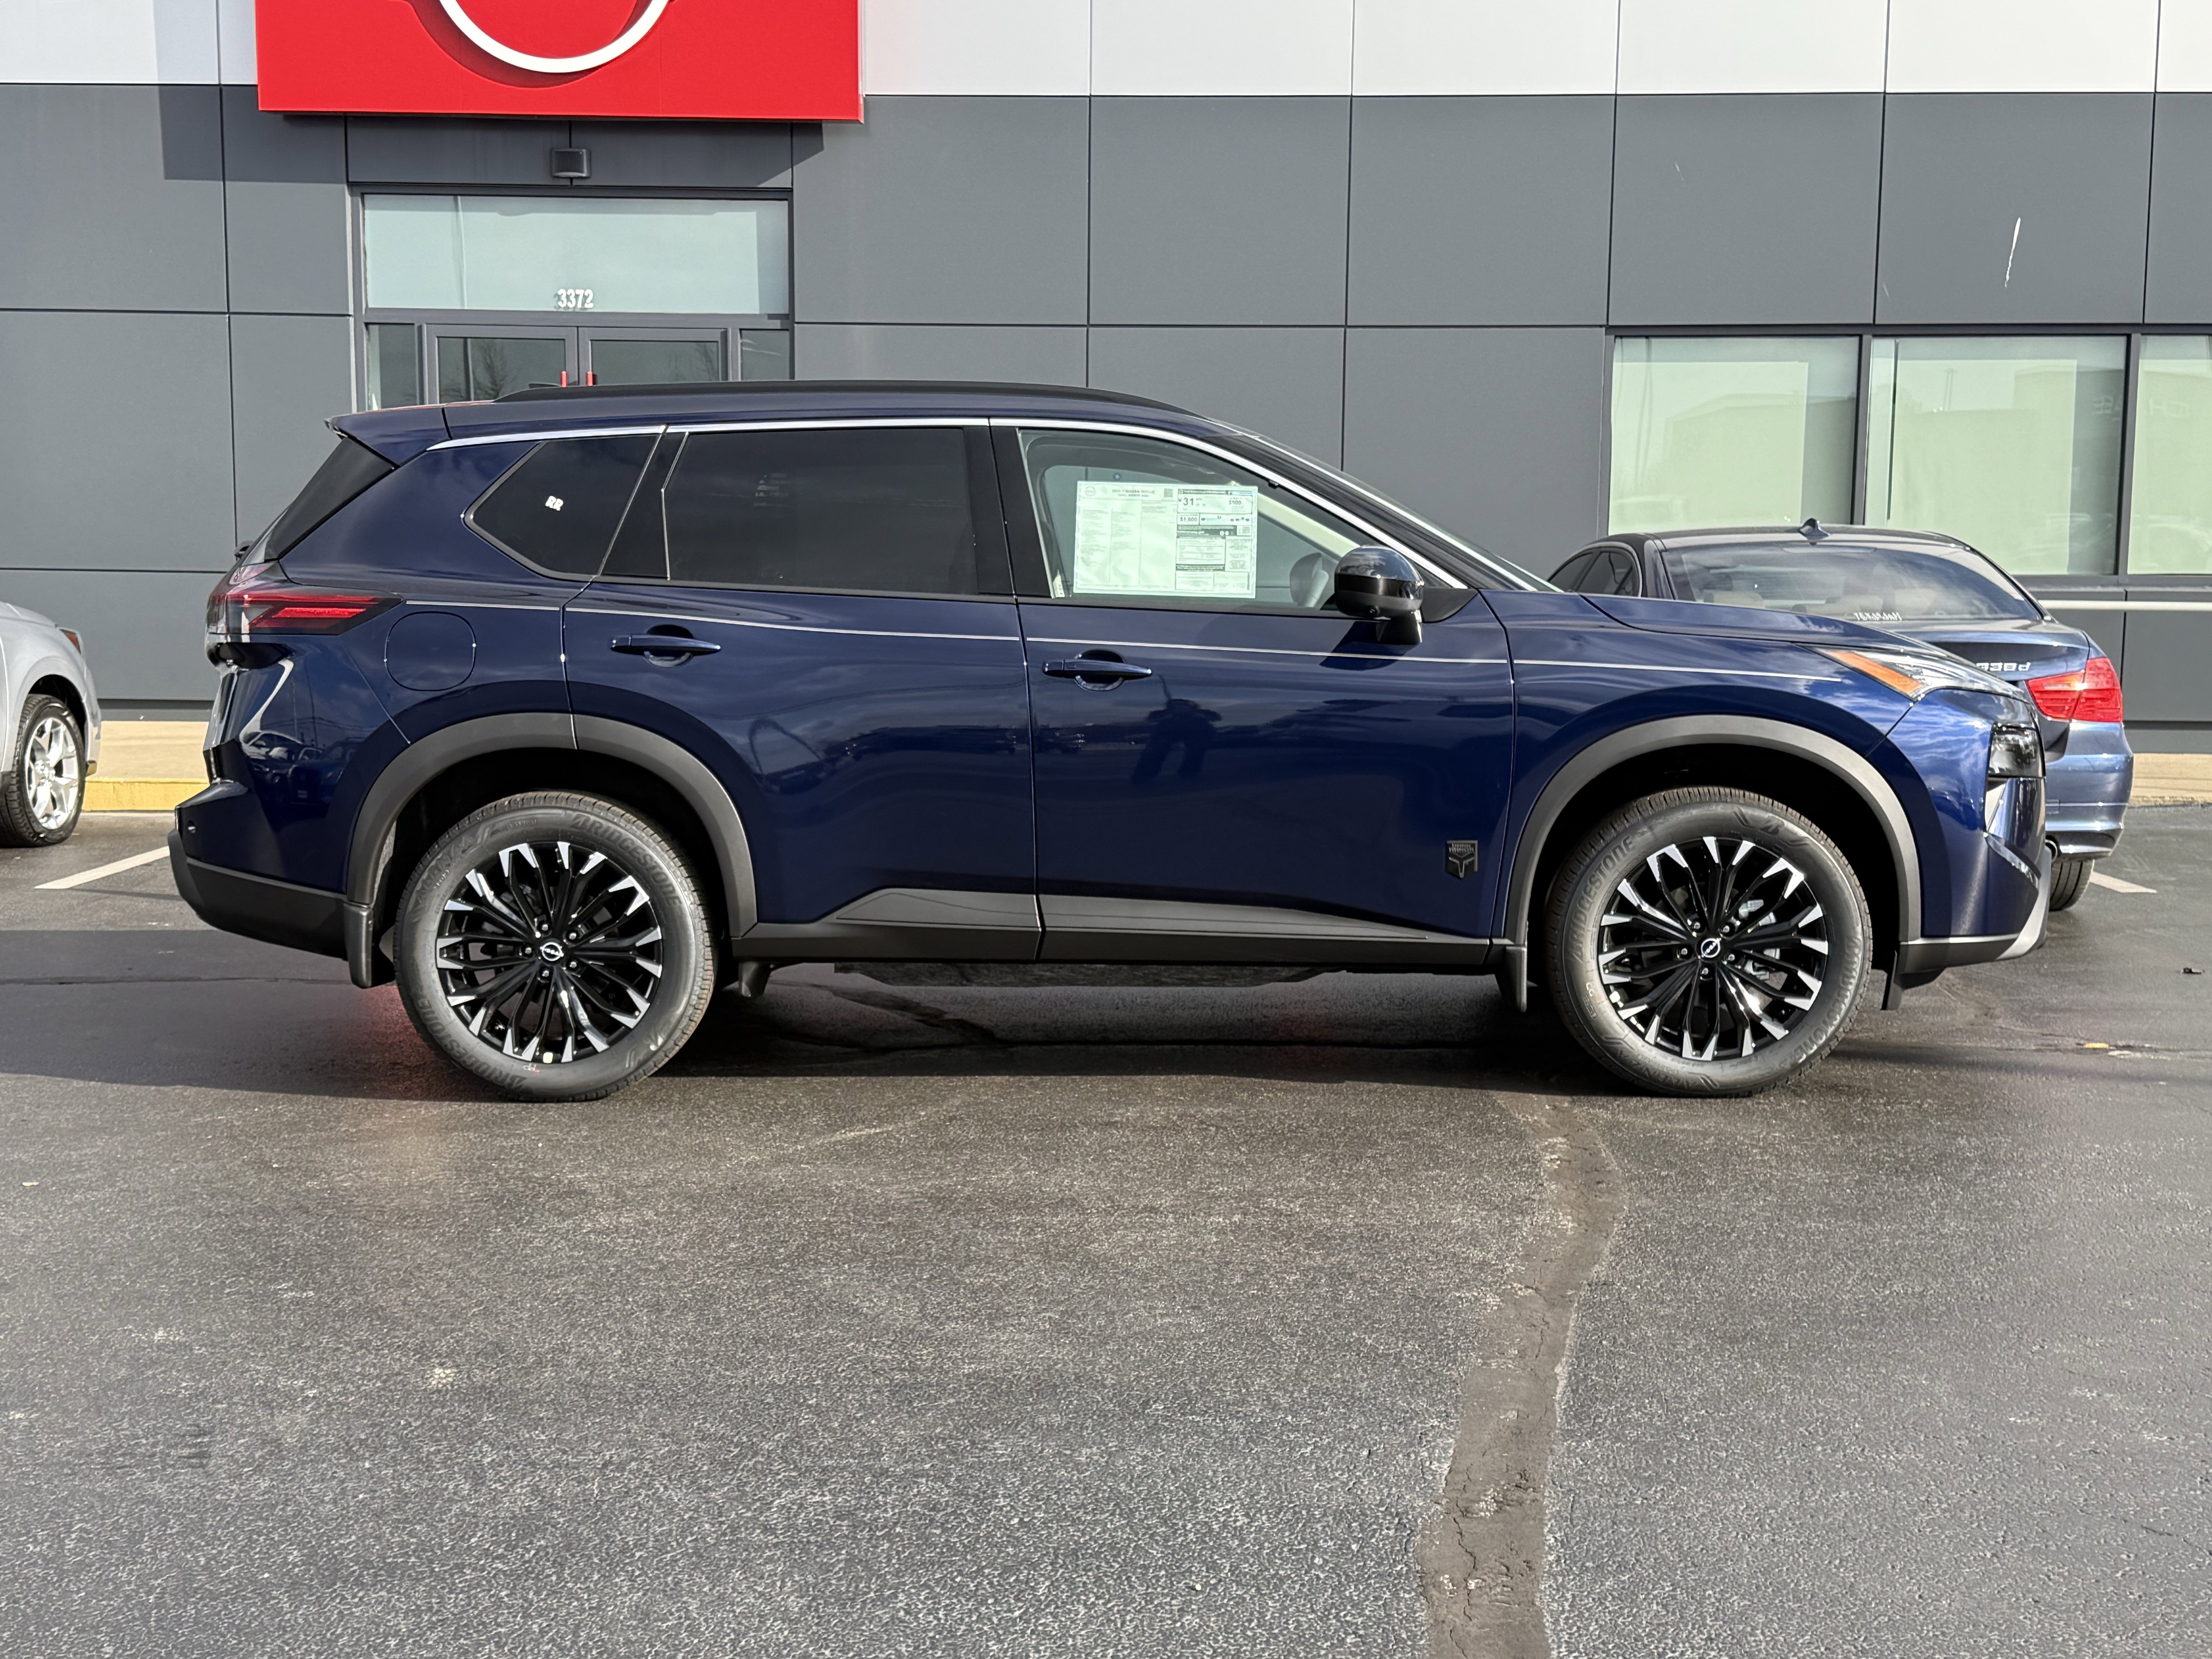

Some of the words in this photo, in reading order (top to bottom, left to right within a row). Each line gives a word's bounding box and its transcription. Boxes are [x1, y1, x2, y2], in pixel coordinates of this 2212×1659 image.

[558, 289, 594, 308] 3372
[1183, 497, 1194, 506] 31
[570, 814, 682, 907] BRIDGESTONE
[1568, 835, 1635, 963] BRIDGESTONE
[417, 998, 527, 1091] BRIDGESTONE
